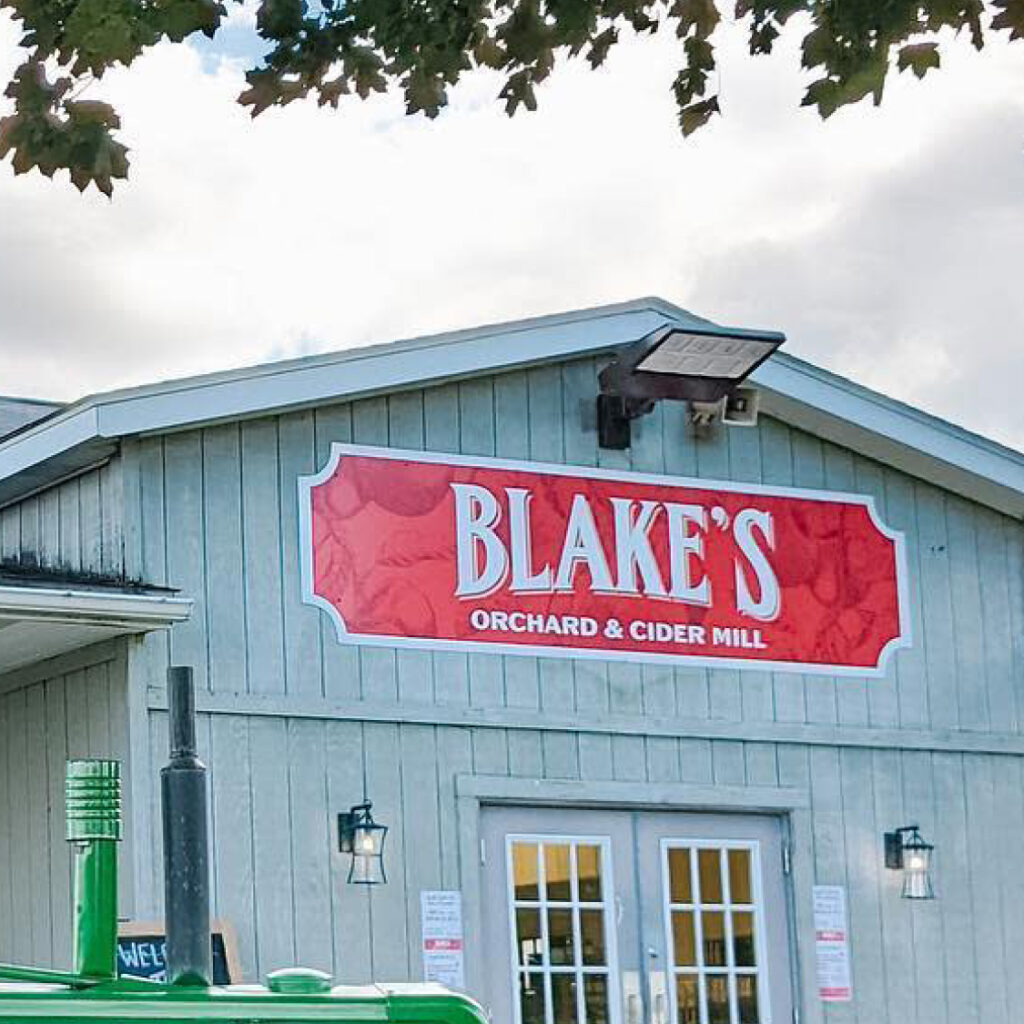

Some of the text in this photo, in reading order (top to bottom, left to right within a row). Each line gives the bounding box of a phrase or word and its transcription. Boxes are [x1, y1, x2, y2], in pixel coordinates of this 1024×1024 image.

[450, 482, 781, 622] BLAKE'S
[470, 608, 768, 649] ORCHARD & CIDER MILL
